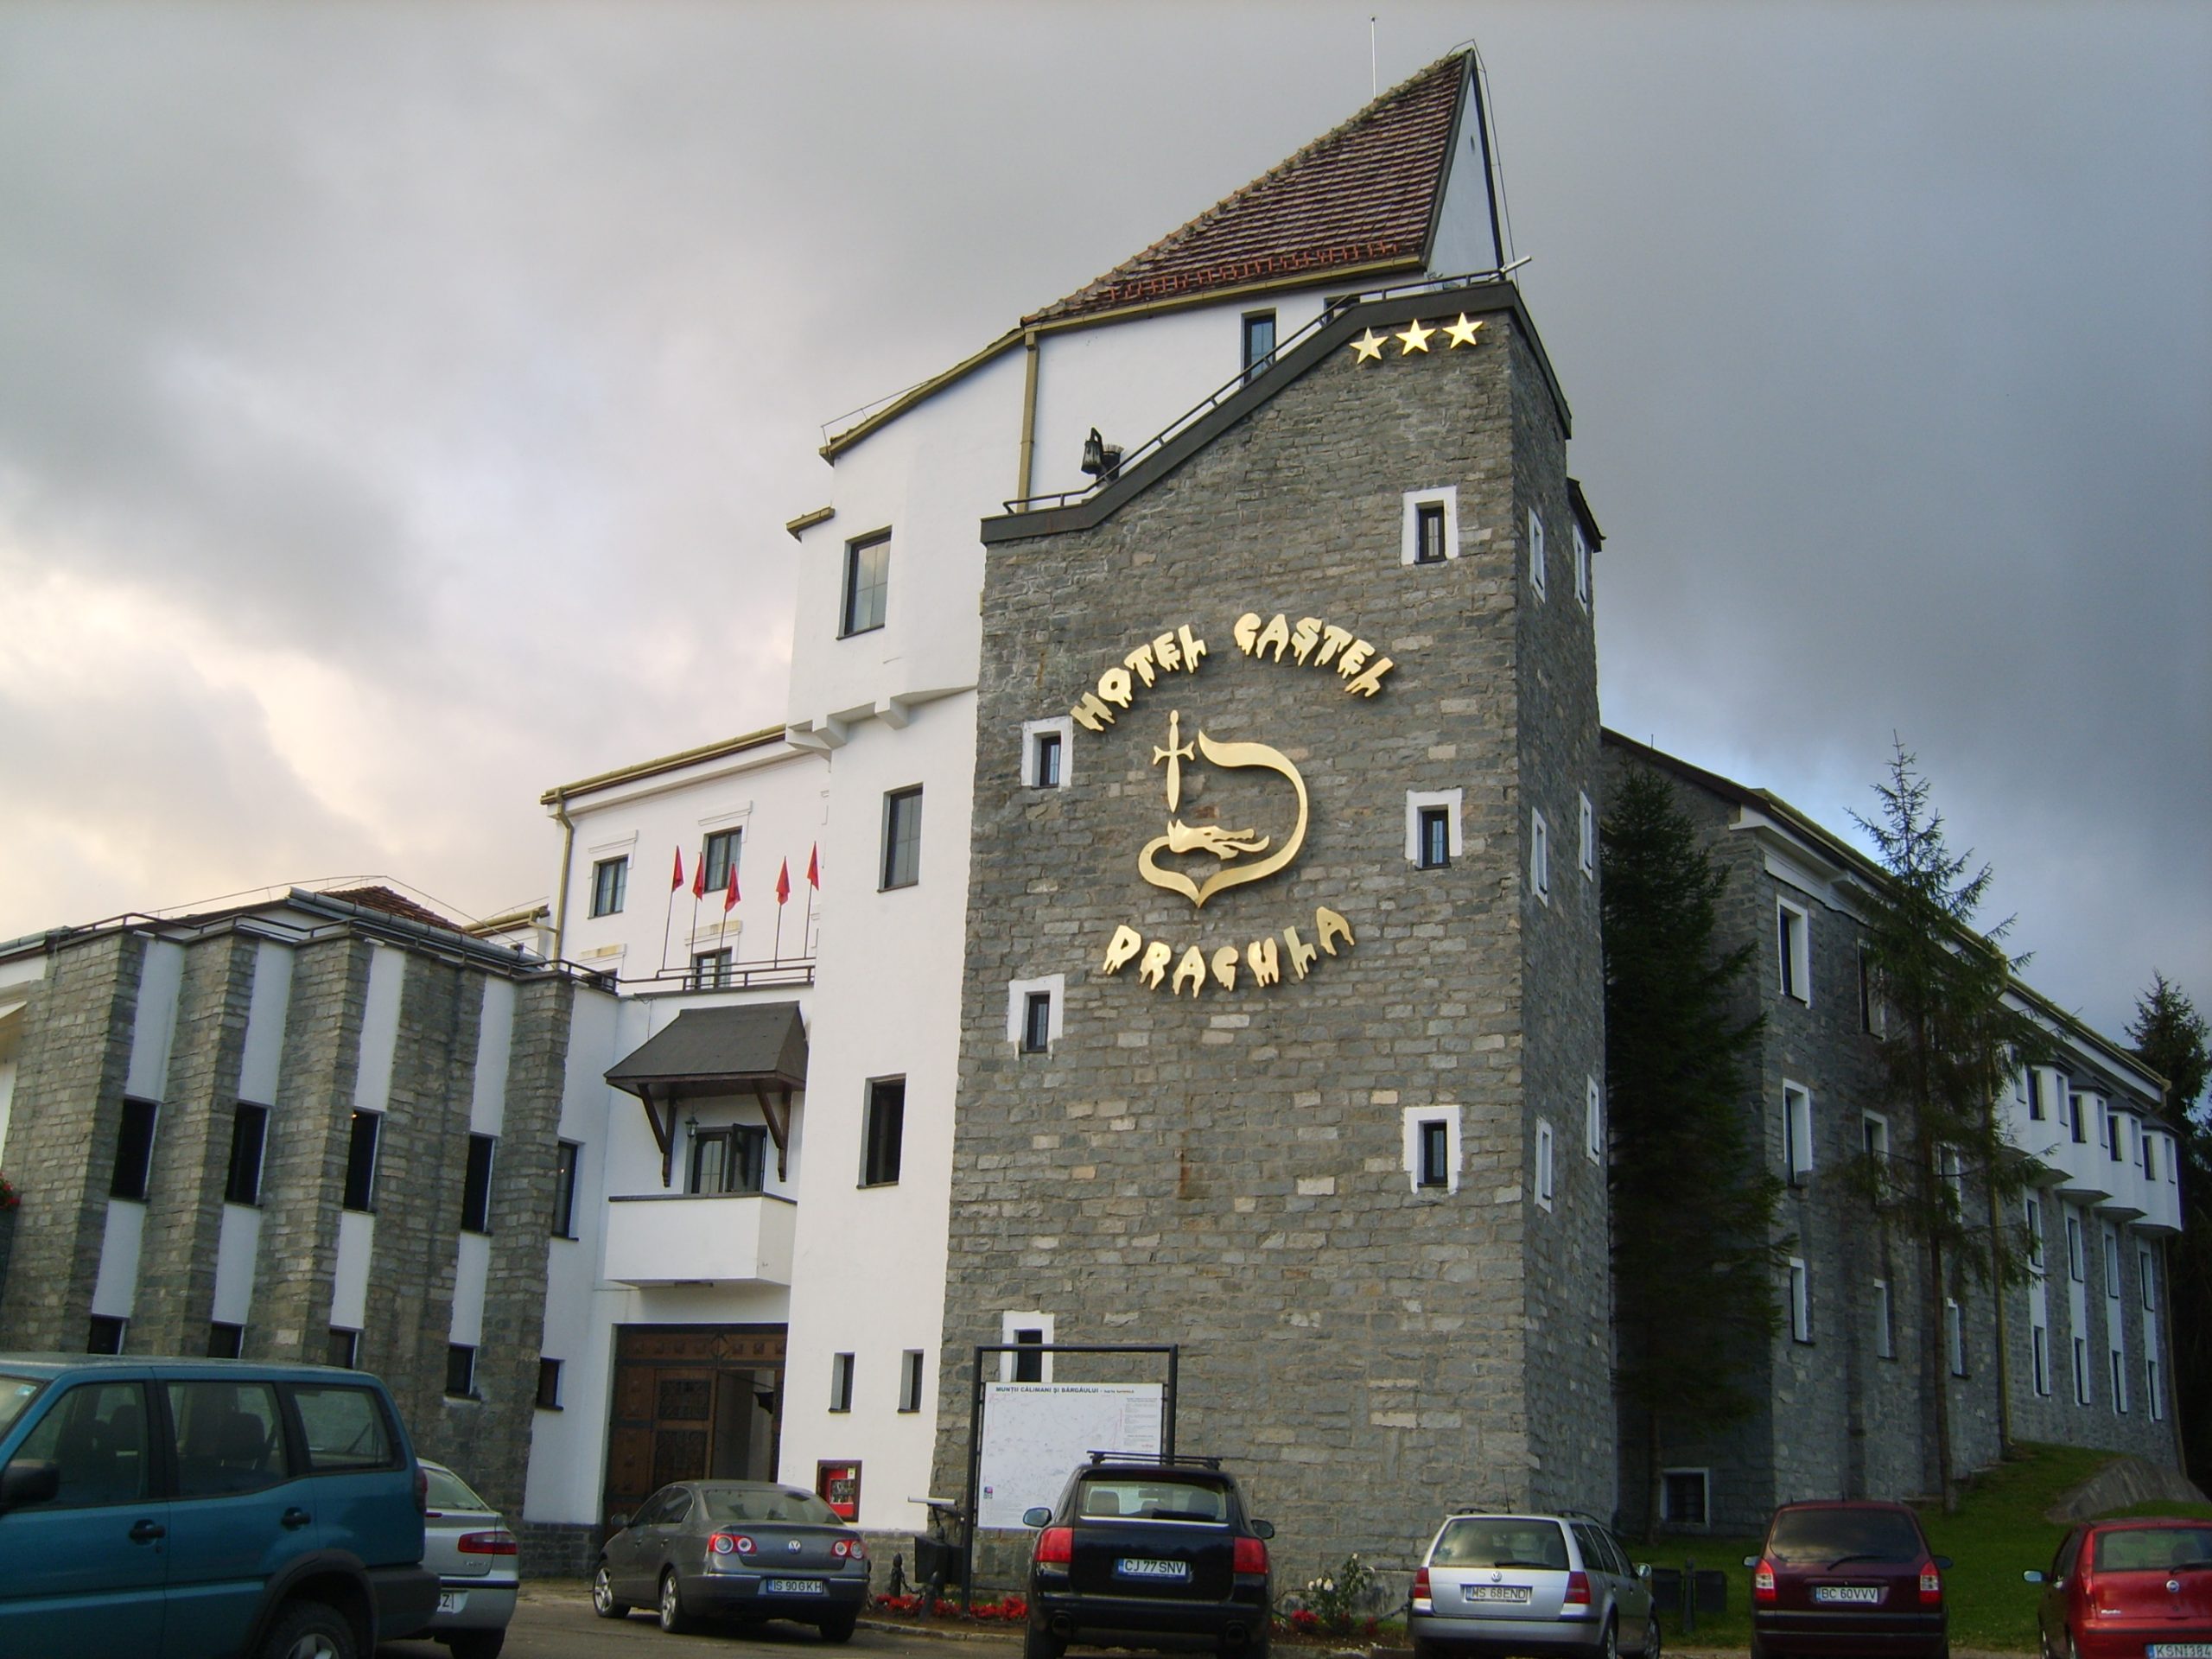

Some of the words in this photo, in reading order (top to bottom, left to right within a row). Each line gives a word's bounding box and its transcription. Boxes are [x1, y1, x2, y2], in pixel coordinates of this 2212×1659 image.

[1071, 624, 1206, 732] HOTEL
[1234, 613, 1394, 697] CASTEL
[1103, 906, 1355, 999] DRACULA
[1125, 1560, 1140, 1571] CJ
[1143, 1560, 1157, 1572] 77
[1159, 1561, 1184, 1573] SNV
[1821, 1588, 1836, 1598] BC
[2157, 1644, 2183, 1656] KSN
